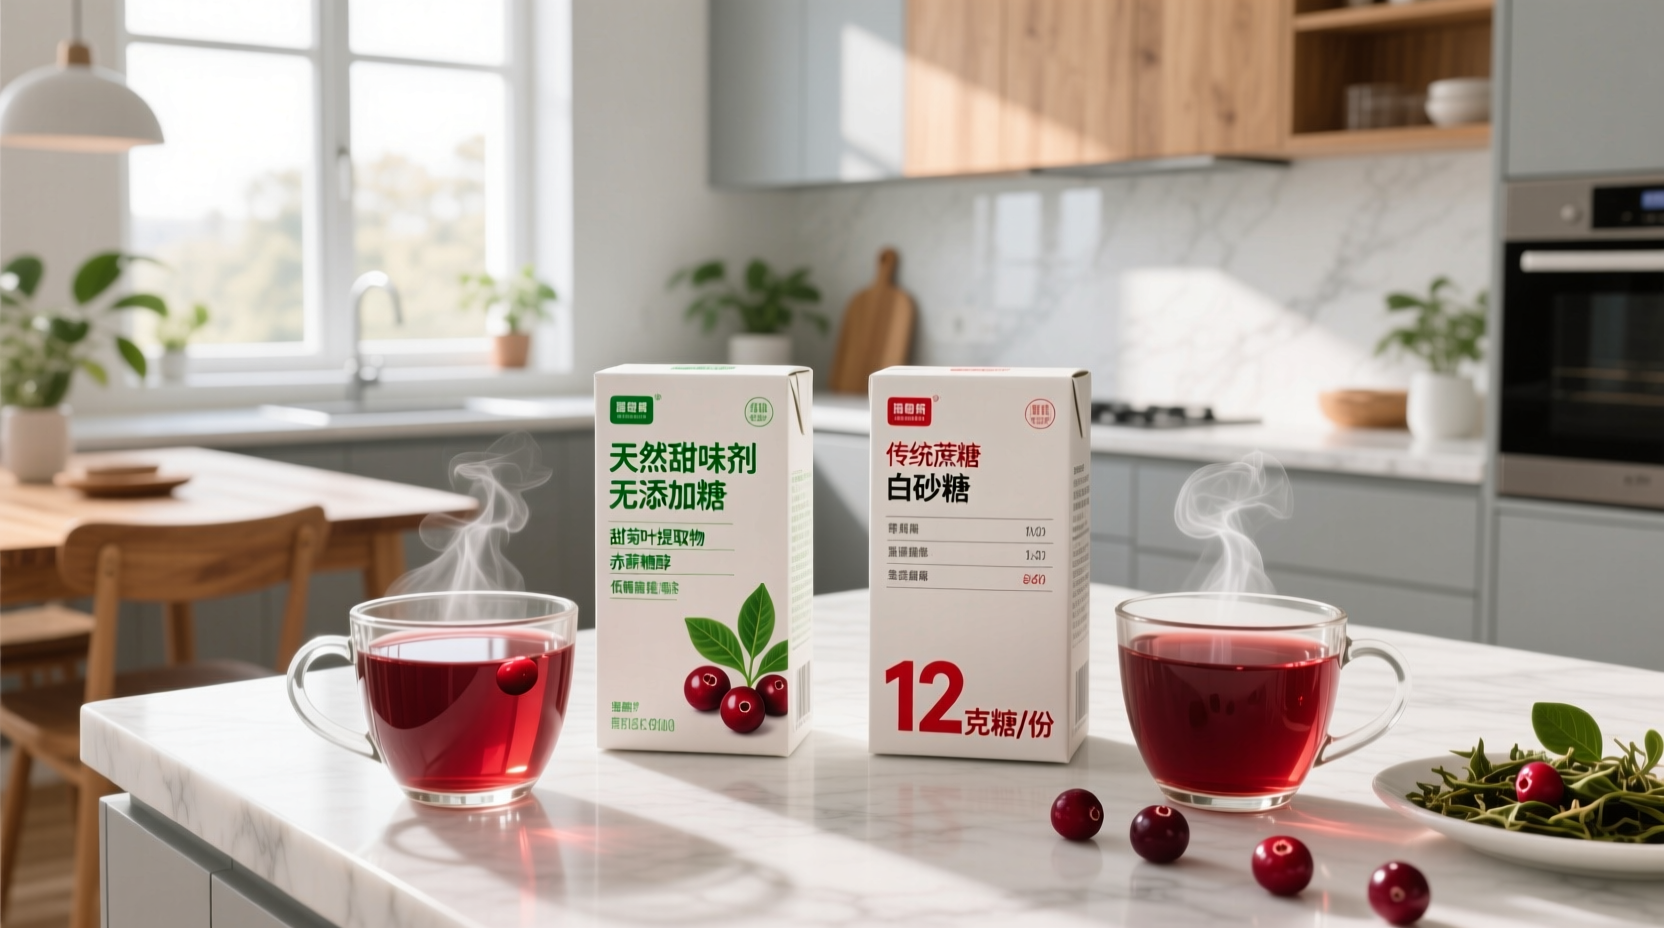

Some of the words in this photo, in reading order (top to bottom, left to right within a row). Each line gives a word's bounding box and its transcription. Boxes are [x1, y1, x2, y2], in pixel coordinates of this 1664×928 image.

[609, 441, 757, 475] 天然甜味剂
[886, 441, 981, 468] 传统蔗糖
[609, 479, 727, 511] 无添加糖
[887, 473, 971, 503] 白砂糖
[610, 527, 706, 547] 甜菊叶提取物
